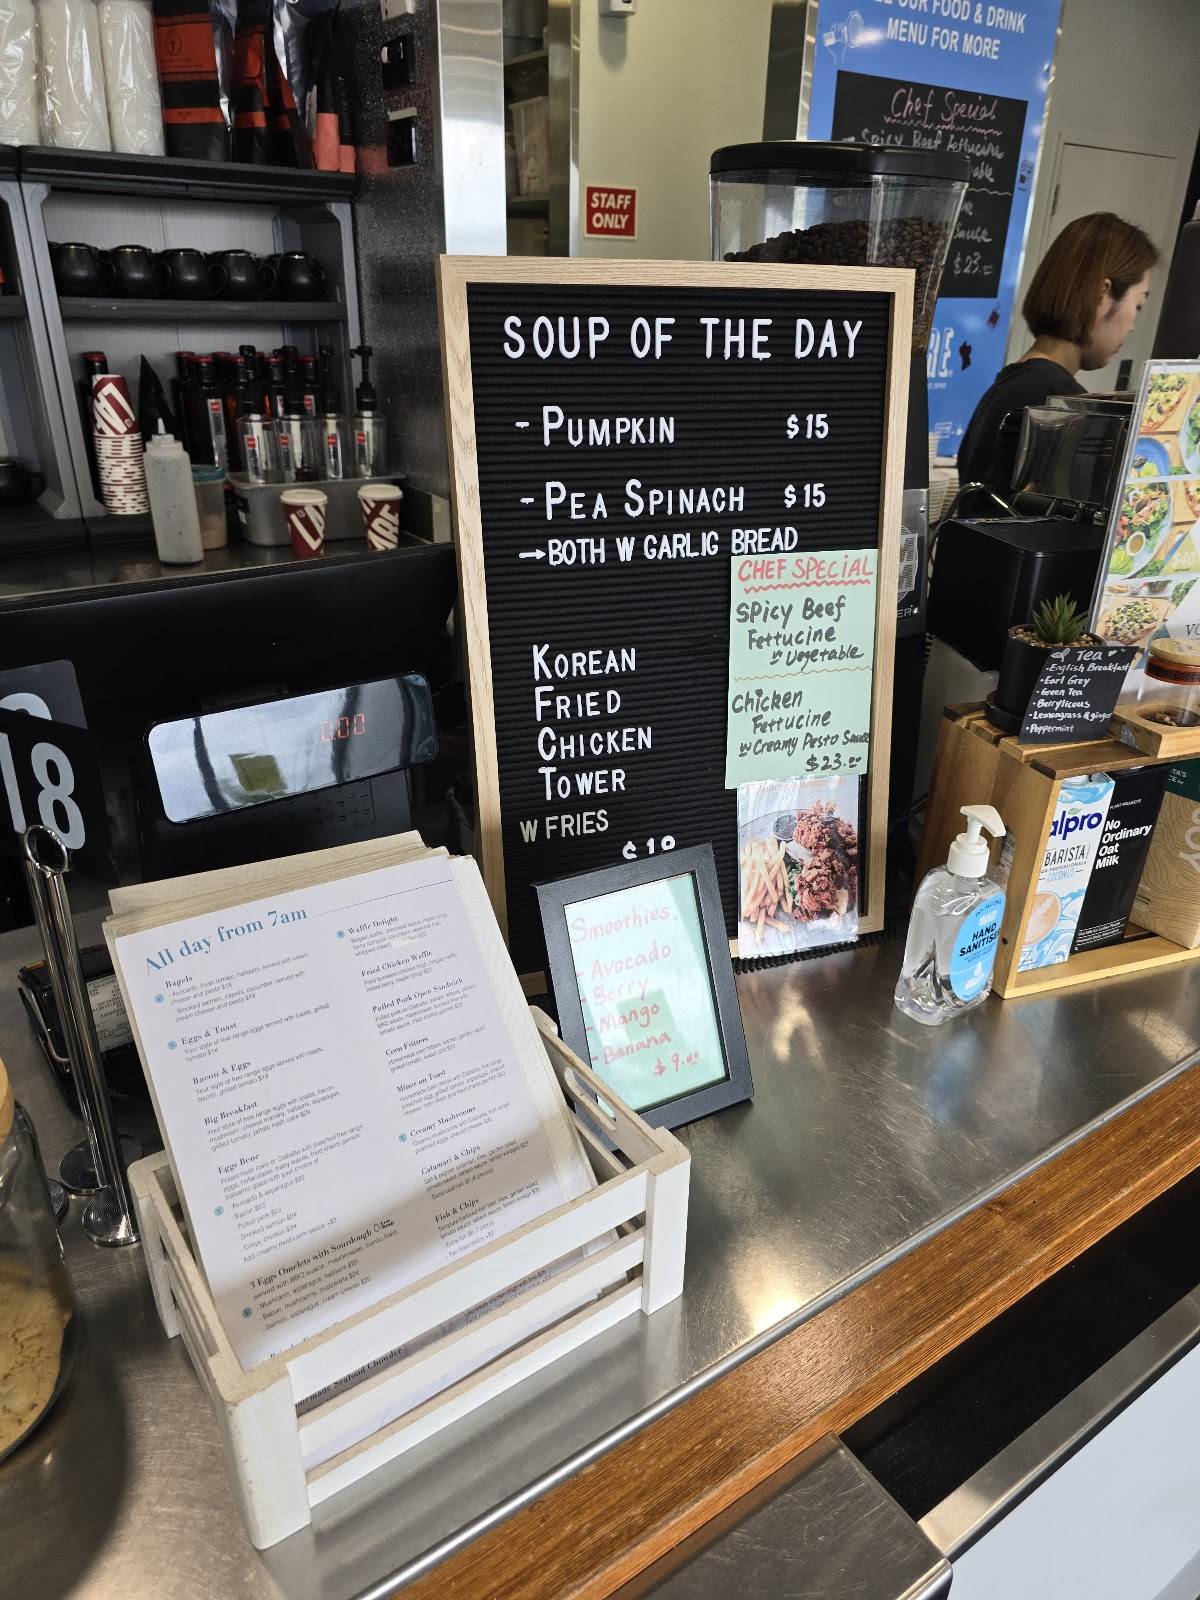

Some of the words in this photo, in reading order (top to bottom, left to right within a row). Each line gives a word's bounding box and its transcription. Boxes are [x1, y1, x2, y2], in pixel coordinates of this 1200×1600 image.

[932, 0, 970, 21] FOOD
[974, 3, 983, 24] &
[986, 6, 1026, 34] DRINK
[886, 17, 928, 46] MENU
[930, 26, 959, 52] FOR
[962, 33, 1001, 60] MORE
[891, 87, 935, 124] Chef
[590, 191, 632, 210] STAFF
[592, 212, 629, 230] ONLY
[503, 315, 610, 360] SOUP
[630, 317, 676, 360] OF
[700, 317, 773, 361] THE
[794, 318, 863, 360] DAY
[785, 413, 830, 439] $15
[783, 482, 826, 509] $15
[548, 537, 606, 566] BOTH
[616, 536, 636, 562] W
[731, 526, 799, 554] BREAD
[738, 558, 787, 582] CHEF
[802, 595, 846, 623] Beef
[1076, 650, 1103, 662] Tea
[1049, 663, 1085, 675] English
[1087, 662, 1130, 673] Breakfast
[1040, 687, 1066, 696] Green
[1068, 687, 1083, 696] Tea
[1044, 675, 1066, 685] Earl
[1067, 674, 1091, 688] Grey
[731, 688, 803, 714] Chicken
[320, 713, 366, 743] 0.00
[1029, 723, 1075, 734] Peppermint
[752, 737, 798, 757] Creamy
[520, 819, 538, 843] W
[545, 809, 609, 840] FRIES
[1101, 824, 1153, 844] Ordinary
[1104, 819, 1121, 832] No
[1044, 844, 1086, 867] BARISTA
[1098, 843, 1120, 856] Oat
[1095, 854, 1120, 869] Milk
[348, 924, 370, 934] Waffle
[373, 917, 397, 927] Delight
[972, 922, 997, 942] HAND
[145, 948, 175, 976] All
[179, 936, 212, 954] day
[217, 919, 263, 943] from
[267, 909, 308, 927] 7am
[362, 966, 380, 976] Fried
[382, 959, 409, 970] Chicken
[411, 951, 431, 960] Waffle
[591, 940, 671, 980] Avocado
[166, 976, 192, 988] Bagels
[592, 977, 649, 1006] Berry
[372, 1000, 394, 1012] Pulled
[396, 995, 412, 1004] Pork
[414, 990, 431, 998] Open
[433, 978, 462, 992] Sandwich
[600, 1003, 660, 1034] Mango
[182, 1036, 202, 1045] Eggs
[213, 1022, 237, 1036] Toast
[386, 1047, 402, 1055] Corn
[603, 1031, 671, 1064] Banana
[193, 1073, 218, 1084] Bacon
[231, 1062, 250, 1071] Eggs
[396, 1082, 416, 1093] Mince
[429, 1070, 445, 1080] Toast
[205, 1116, 218, 1125] Big
[220, 1102, 256, 1119] Breakfast
[410, 1123, 435, 1136] Creamy
[438, 1108, 475, 1126] Mushrooms
[218, 1164, 237, 1174] Eggs
[240, 1155, 259, 1165] Bene
[422, 1157, 452, 1174] Calamari
[461, 1146, 480, 1156] Chips
[436, 1211, 450, 1222] Fish
[460, 1200, 478, 1210] Chips
[258, 1274, 277, 1286] Eggs
[279, 1260, 310, 1276] Omelets
[313, 1249, 329, 1260] with
[331, 1230, 371, 1252] Sourdough
[367, 1347, 402, 1371] Chowder
